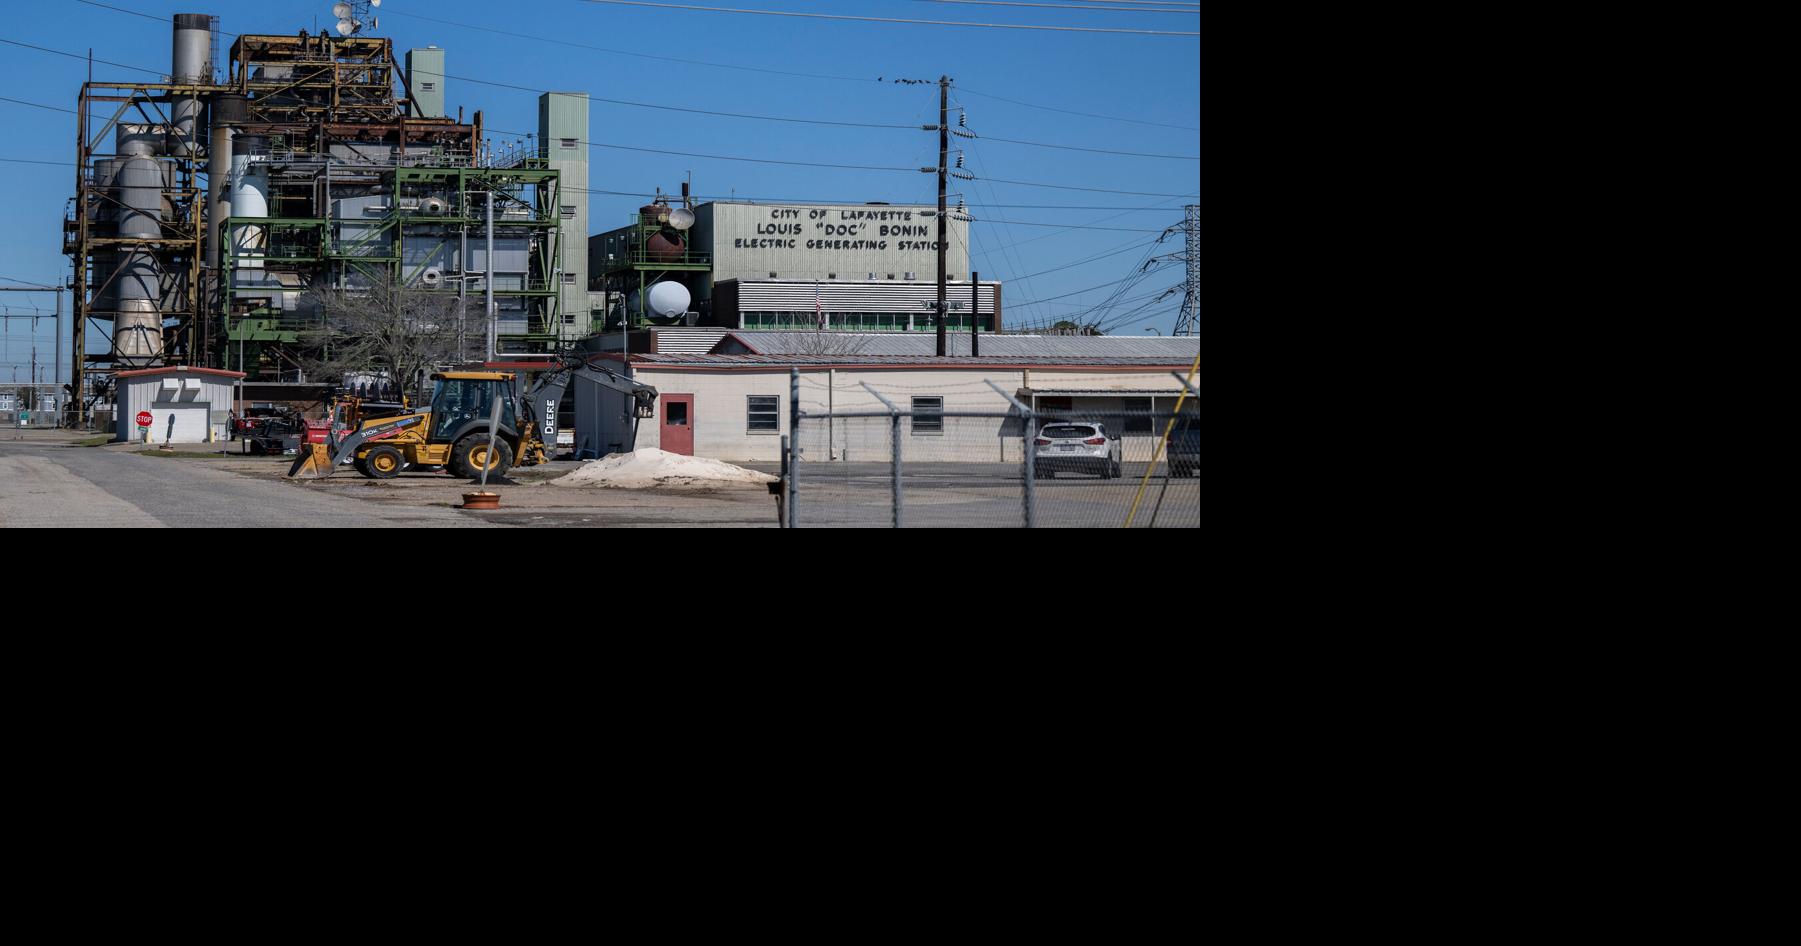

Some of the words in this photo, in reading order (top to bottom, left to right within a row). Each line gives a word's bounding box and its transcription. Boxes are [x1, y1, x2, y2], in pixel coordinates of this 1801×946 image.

[771, 209, 800, 219] CITY
[809, 209, 827, 219] OF
[841, 210, 911, 221] LAFAYETTE
[757, 223, 802, 235] LOUIS
[879, 225, 928, 237] BONIN
[734, 238, 796, 249] ELECTRIC
[806, 239, 887, 250] GENERATING
[136, 415, 152, 423] STOP
[544, 399, 554, 434] DEERE
[360, 428, 378, 438] 310K
